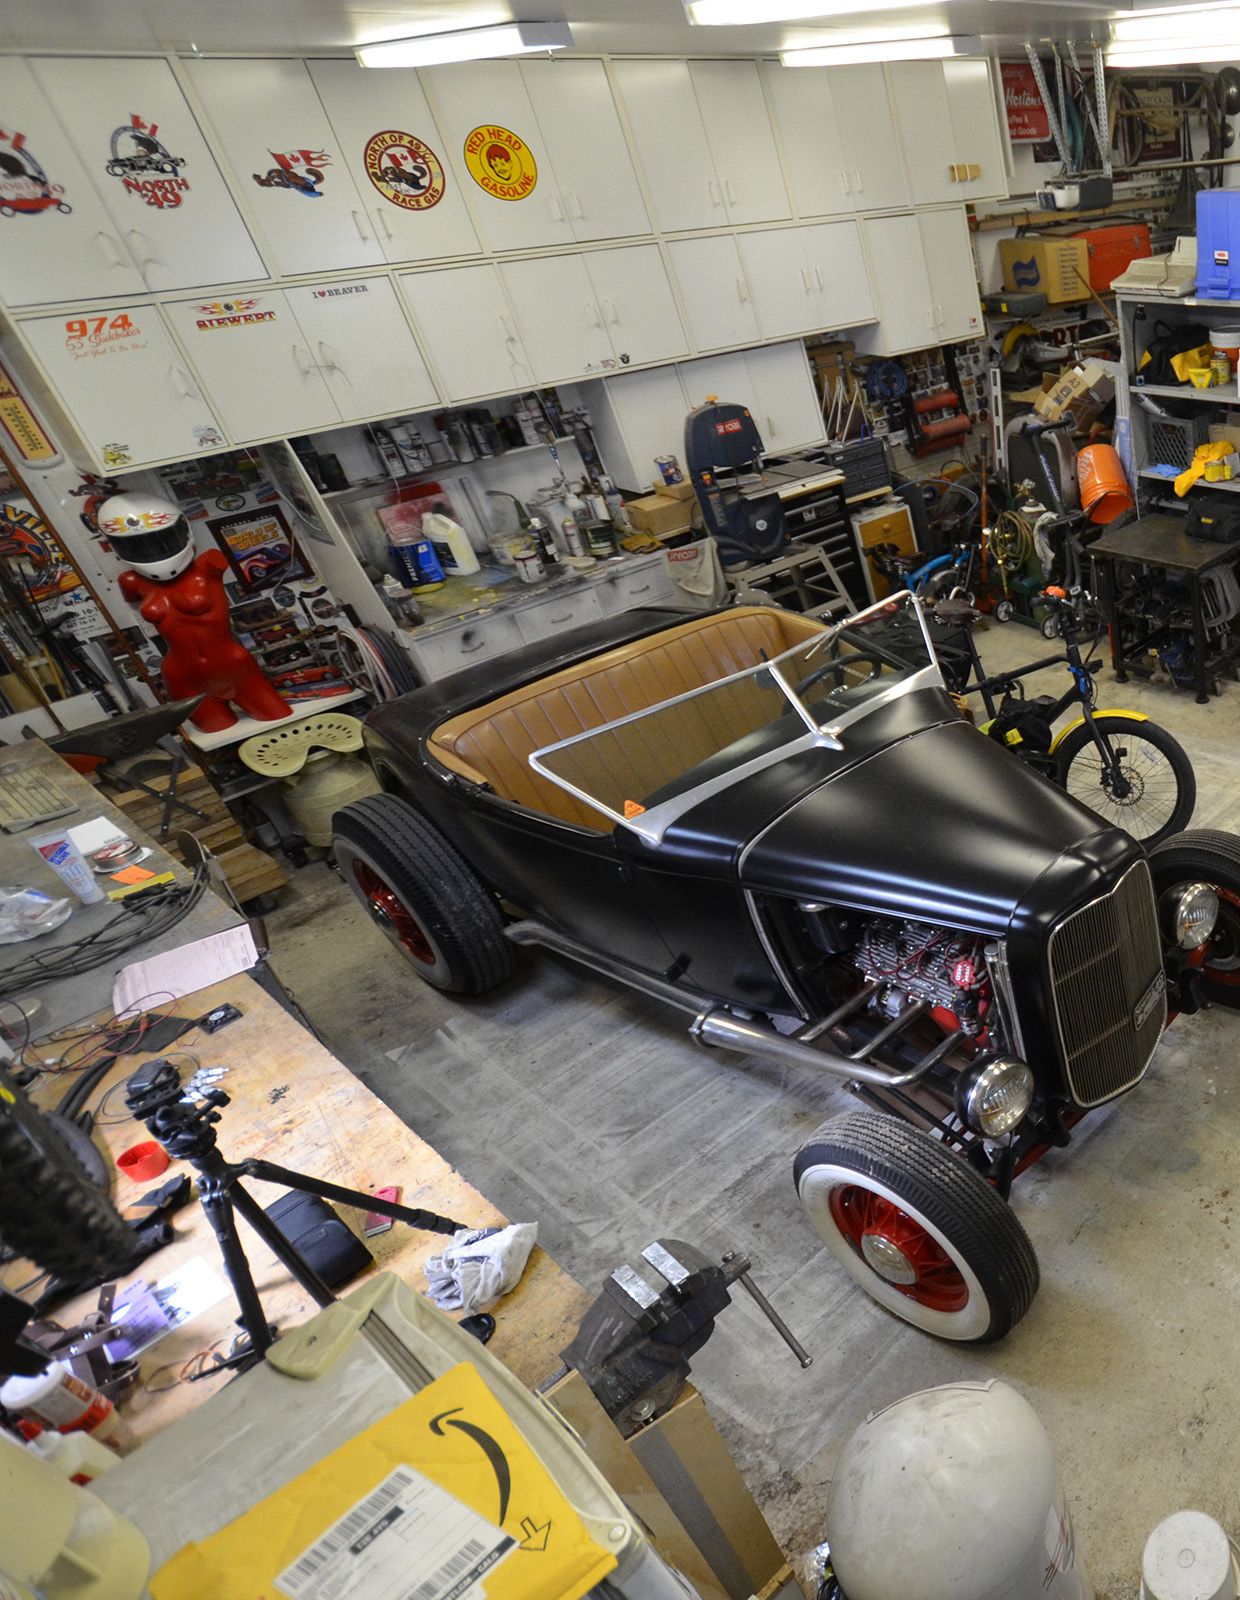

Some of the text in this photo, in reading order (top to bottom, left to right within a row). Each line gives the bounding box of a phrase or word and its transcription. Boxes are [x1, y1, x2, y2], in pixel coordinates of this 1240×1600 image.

[367, 134, 422, 171] NORTH OF 49
[467, 128, 522, 155] RED HEAD
[392, 193, 423, 208] RACE
[423, 186, 440, 204] GAS
[480, 173, 534, 198] GASOLINE
[327, 284, 369, 297] BEAVER
[65, 314, 133, 339] 974
[195, 310, 277, 331] SIEWERT
